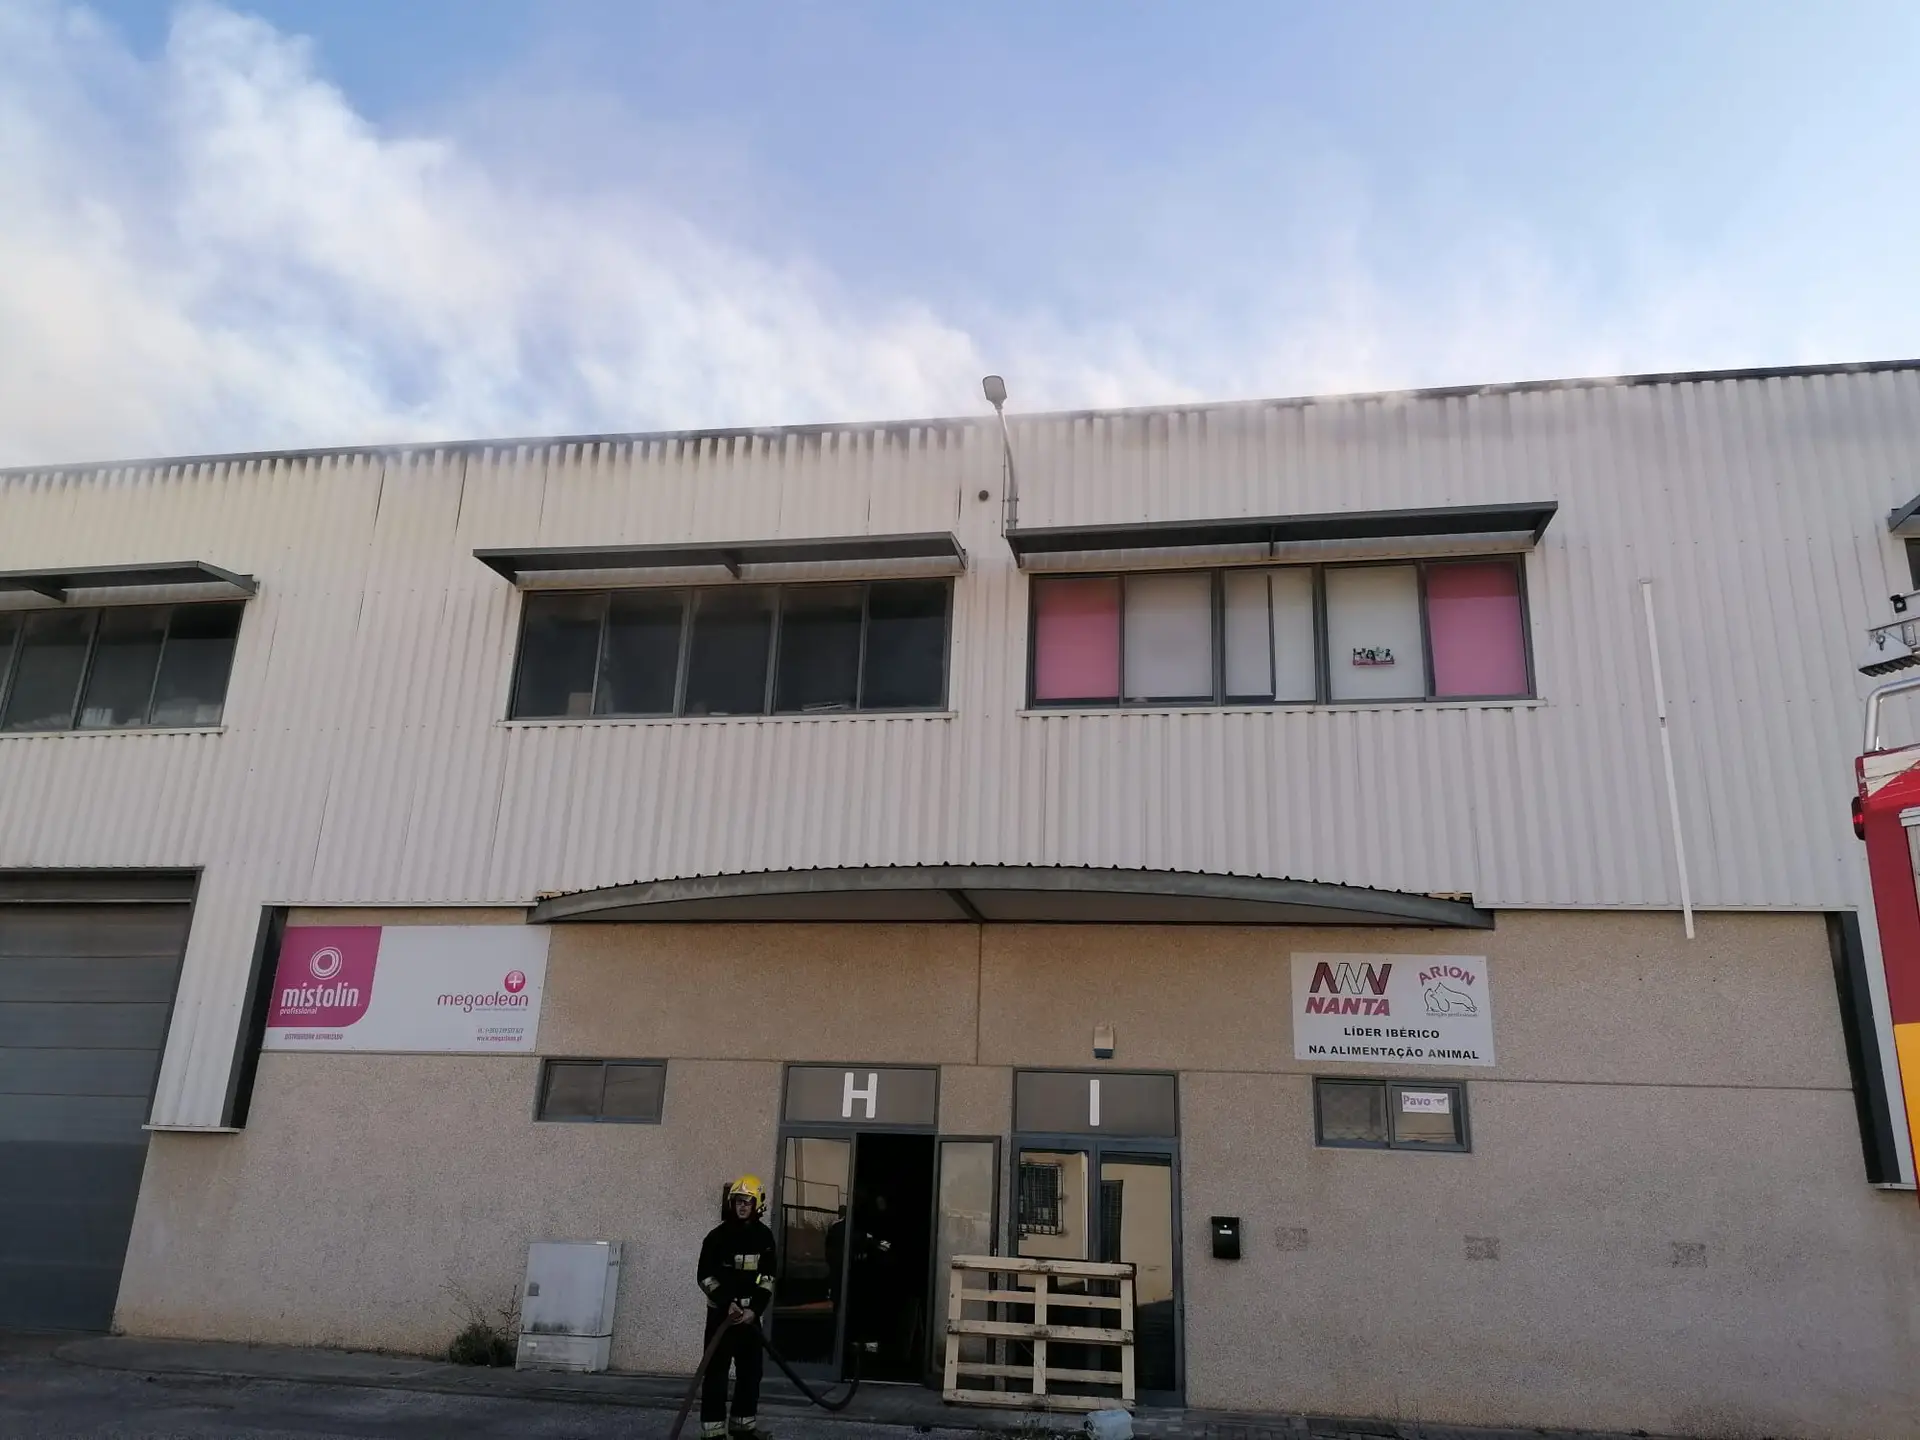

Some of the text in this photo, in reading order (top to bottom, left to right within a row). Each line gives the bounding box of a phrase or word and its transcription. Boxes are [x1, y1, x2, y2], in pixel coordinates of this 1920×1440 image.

[1417, 964, 1476, 987] ARION
[280, 982, 360, 1008] mistolin
[437, 991, 529, 1013] megaclean
[279, 1007, 318, 1016] profissional
[1305, 996, 1391, 1016] NANTA
[1344, 1025, 1440, 1039] LÍDER IBÉRICO
[1308, 1045, 1480, 1060] NA ALIMENTAÇÃO ANIMAL
[841, 1072, 878, 1119] H
[1403, 1095, 1431, 1106] Pavo
